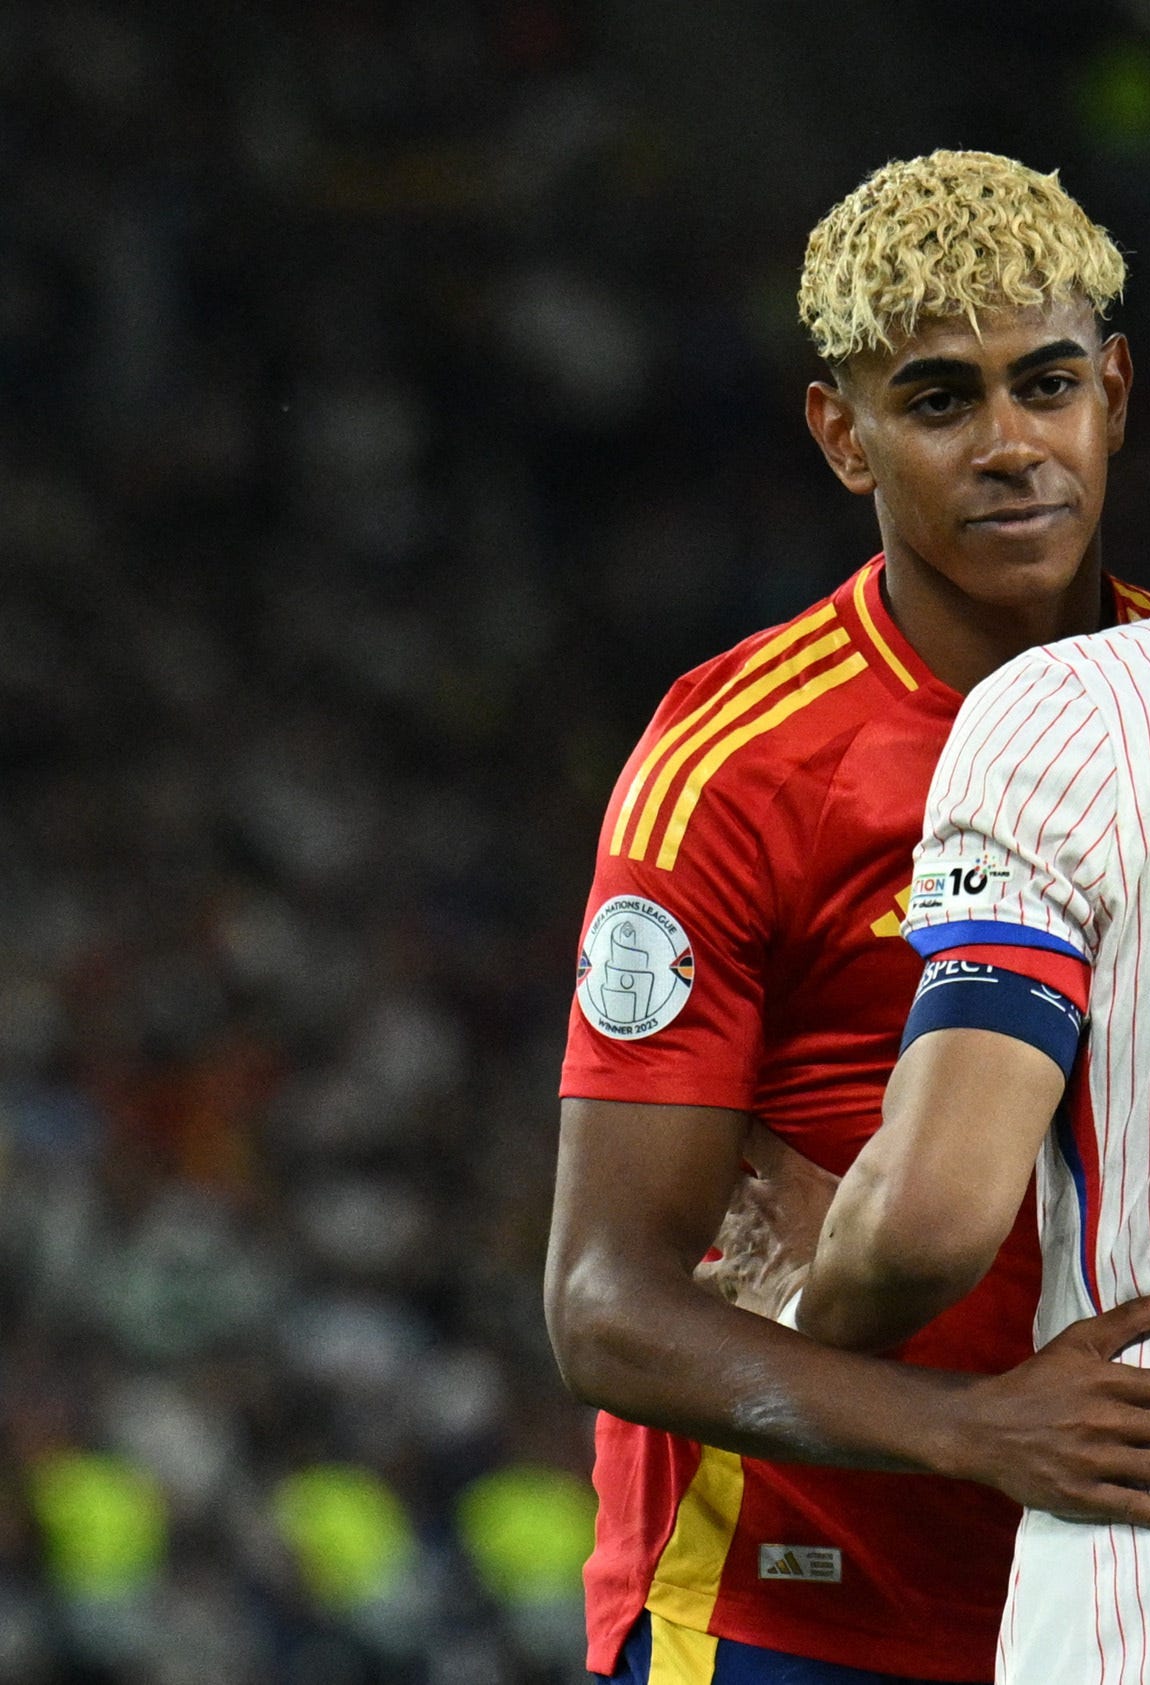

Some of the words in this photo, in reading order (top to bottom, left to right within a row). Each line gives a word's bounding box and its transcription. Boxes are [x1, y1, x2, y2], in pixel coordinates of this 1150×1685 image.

[949, 868, 988, 896] 10
[591, 913, 605, 935] UEFA
[605, 901, 640, 916] NATIONS
[642, 904, 677, 934] LEAGUE
[598, 1017, 633, 1035] WINNER
[635, 1017, 659, 1034] 2023
